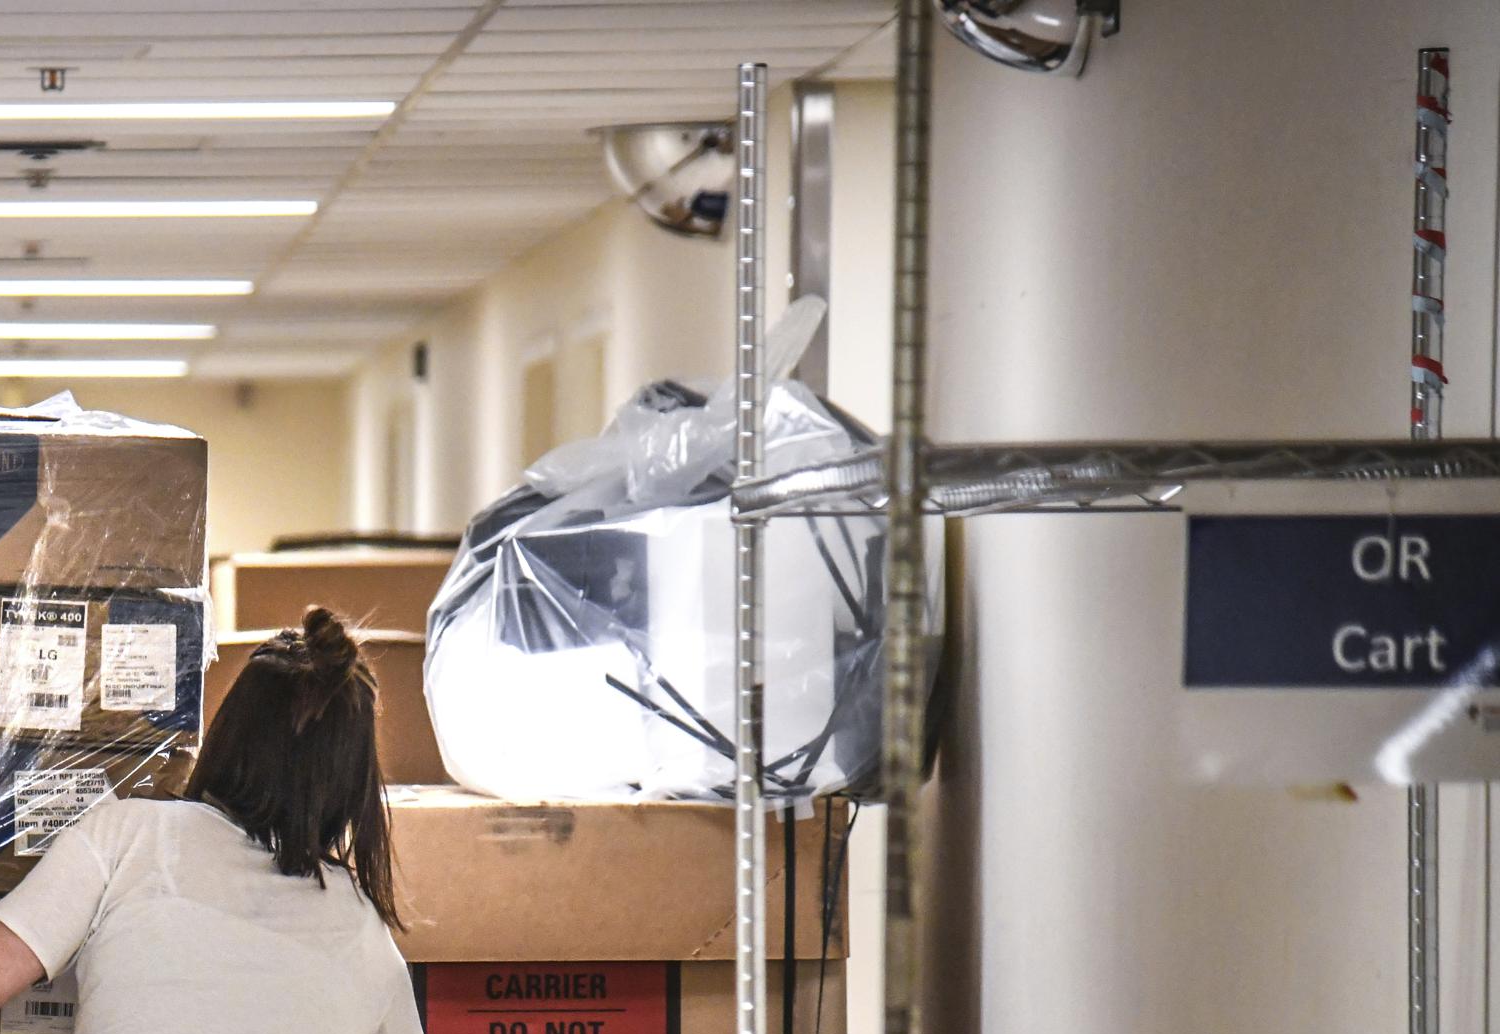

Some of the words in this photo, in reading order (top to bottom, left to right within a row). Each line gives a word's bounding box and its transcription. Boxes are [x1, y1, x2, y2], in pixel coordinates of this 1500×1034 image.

[1351, 535, 1432, 582] OR
[60, 612, 82, 622] 400
[39, 649, 58, 661] LG
[1331, 624, 1447, 672] Cart
[486, 973, 607, 1000] CARRIER
